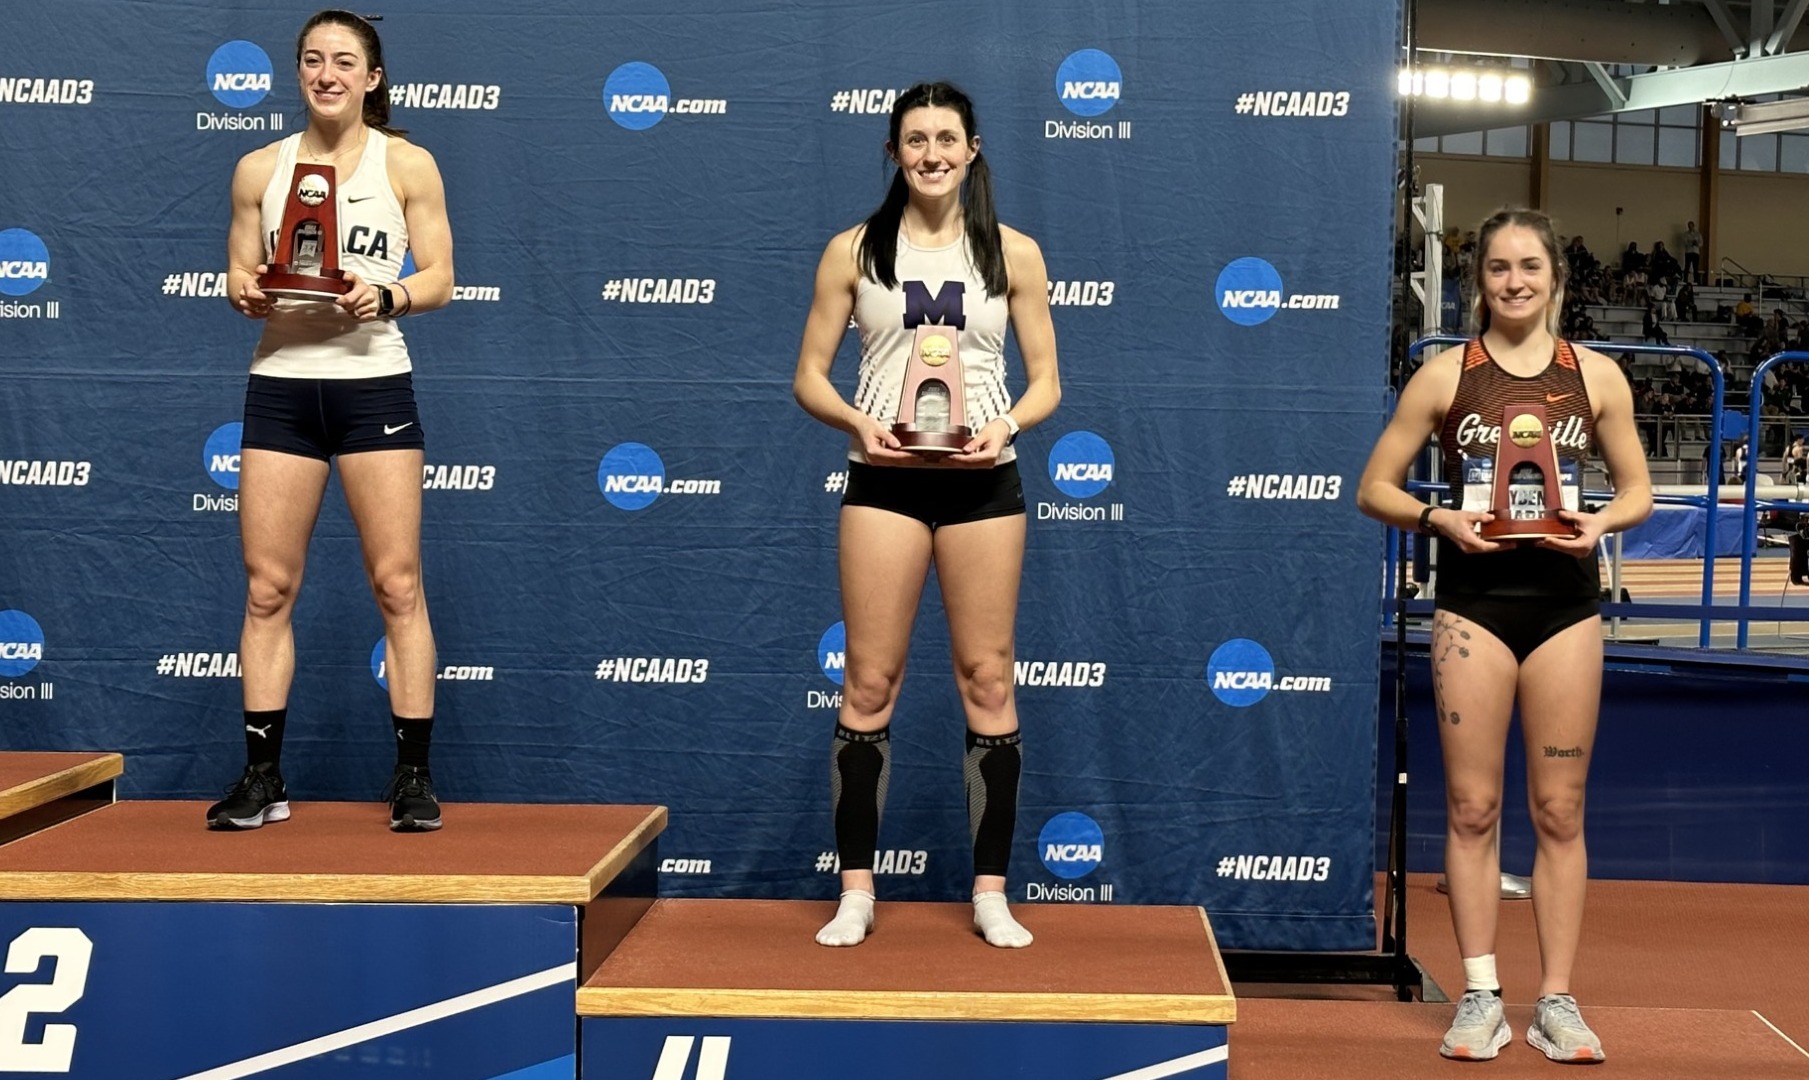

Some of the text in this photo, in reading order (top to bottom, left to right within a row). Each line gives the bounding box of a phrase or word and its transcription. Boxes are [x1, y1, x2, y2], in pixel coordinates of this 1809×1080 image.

[213, 73, 271, 91] NCAA
[1062, 81, 1120, 99] NCAA
[388, 83, 501, 110] #NCAAD3
[610, 95, 726, 114] NCAA.com
[830, 89, 909, 114] #NCA
[1234, 91, 1351, 117] #NCAAD3
[197, 112, 283, 130] Division III
[1045, 120, 1131, 139] Division III
[299, 188, 327, 199] NCAA
[602, 278, 716, 304] #NCAAD3
[1222, 290, 1340, 309] NCAA.com
[46, 301, 59, 319] III
[902, 281, 966, 331] M
[1456, 413, 1588, 449] Greille
[1055, 463, 1113, 482] NCAA
[604, 475, 721, 494] NCAA.com
[1227, 474, 1342, 500] #NCAAD3
[1037, 502, 1124, 521] Division III
[594, 657, 709, 683] #NCAAD3
[1213, 671, 1332, 691] NCAA.com
[40, 683, 53, 699] III
[1044, 844, 1102, 862] NCAA
[1216, 855, 1331, 881] #NCAAD3
[1026, 882, 1113, 902] Division III
[0, 928, 93, 1072] 2
